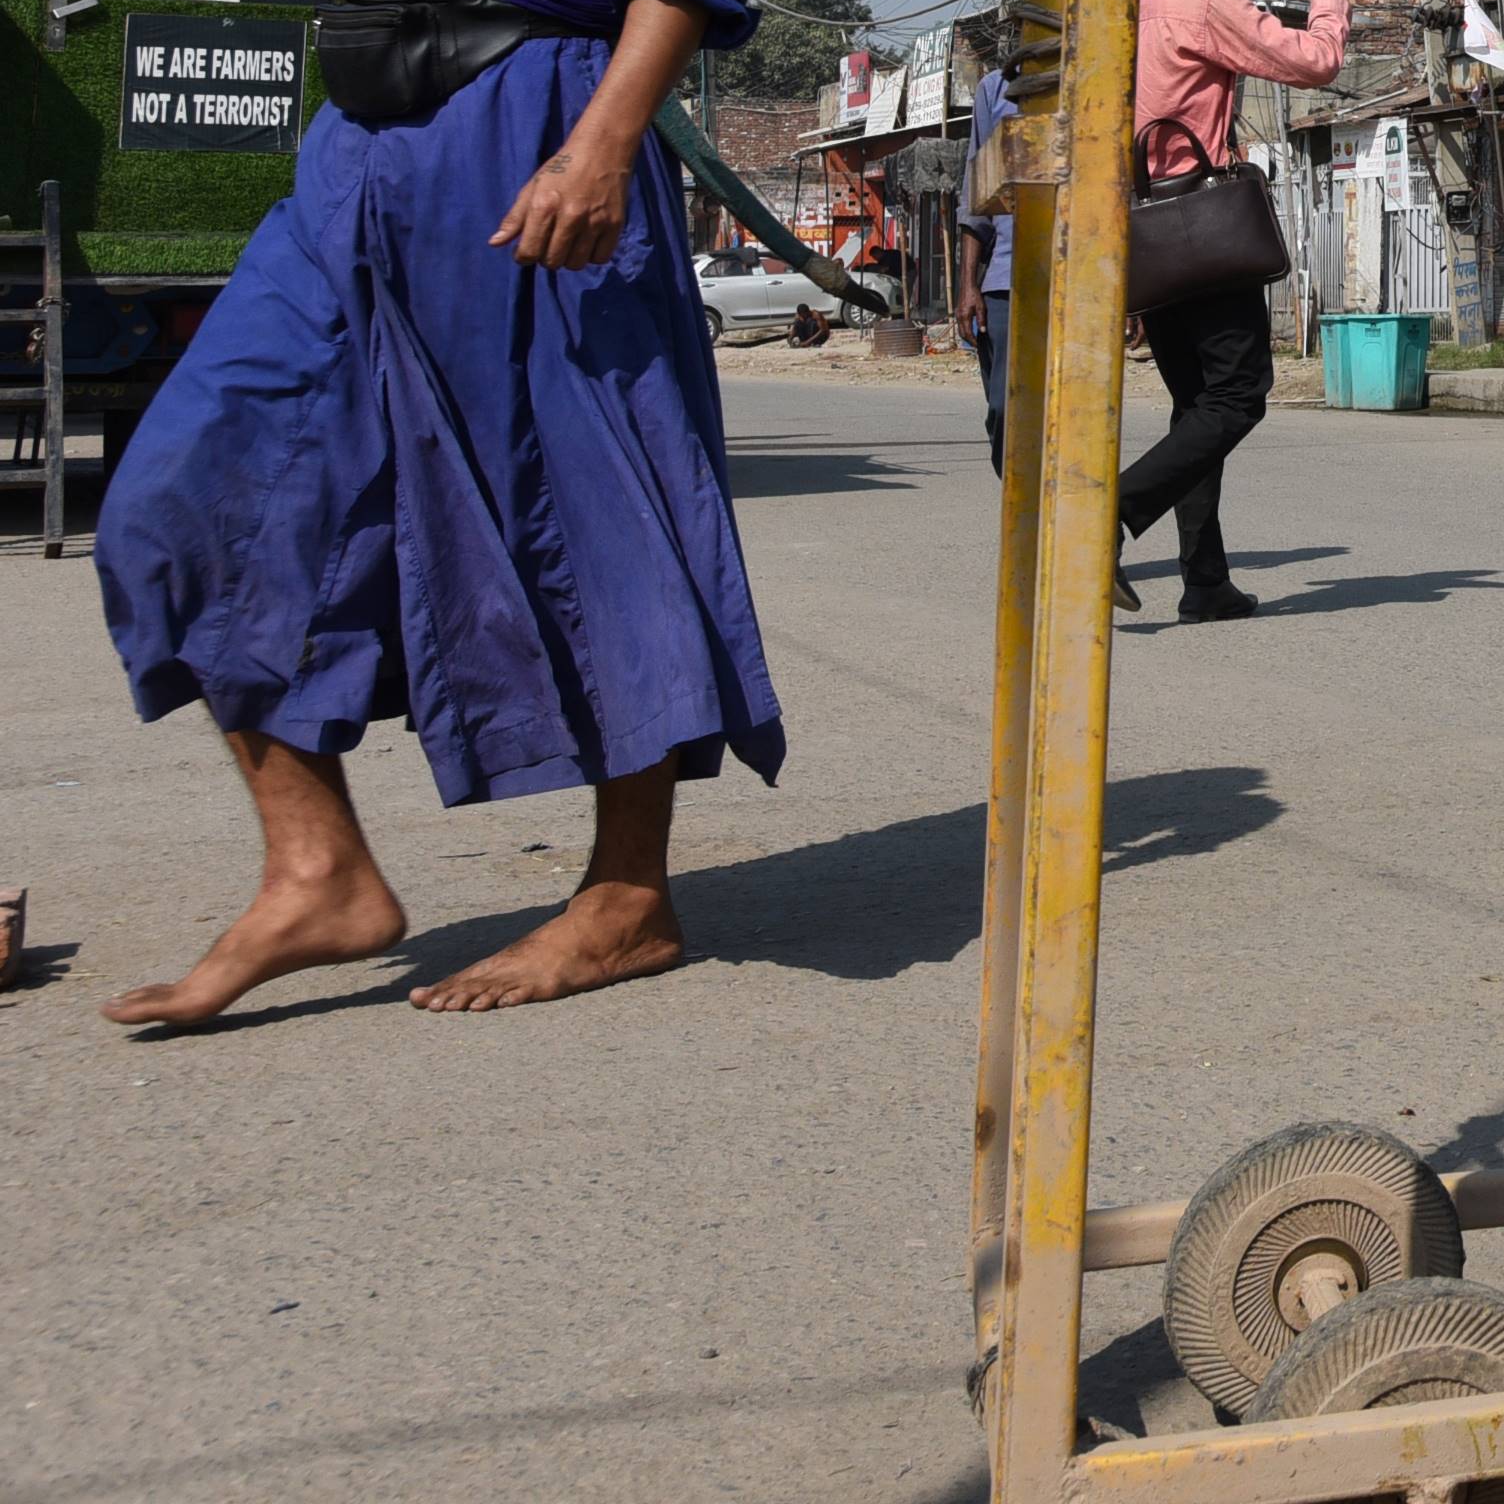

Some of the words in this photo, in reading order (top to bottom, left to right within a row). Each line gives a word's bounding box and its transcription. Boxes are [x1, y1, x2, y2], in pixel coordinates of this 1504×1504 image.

[136, 46, 165, 77] WE
[169, 47, 207, 79] ARE
[211, 48, 294, 82] FARMERS
[132, 92, 171, 123] NOT
[174, 93, 187, 123] A
[193, 94, 293, 126] TERRORIST
